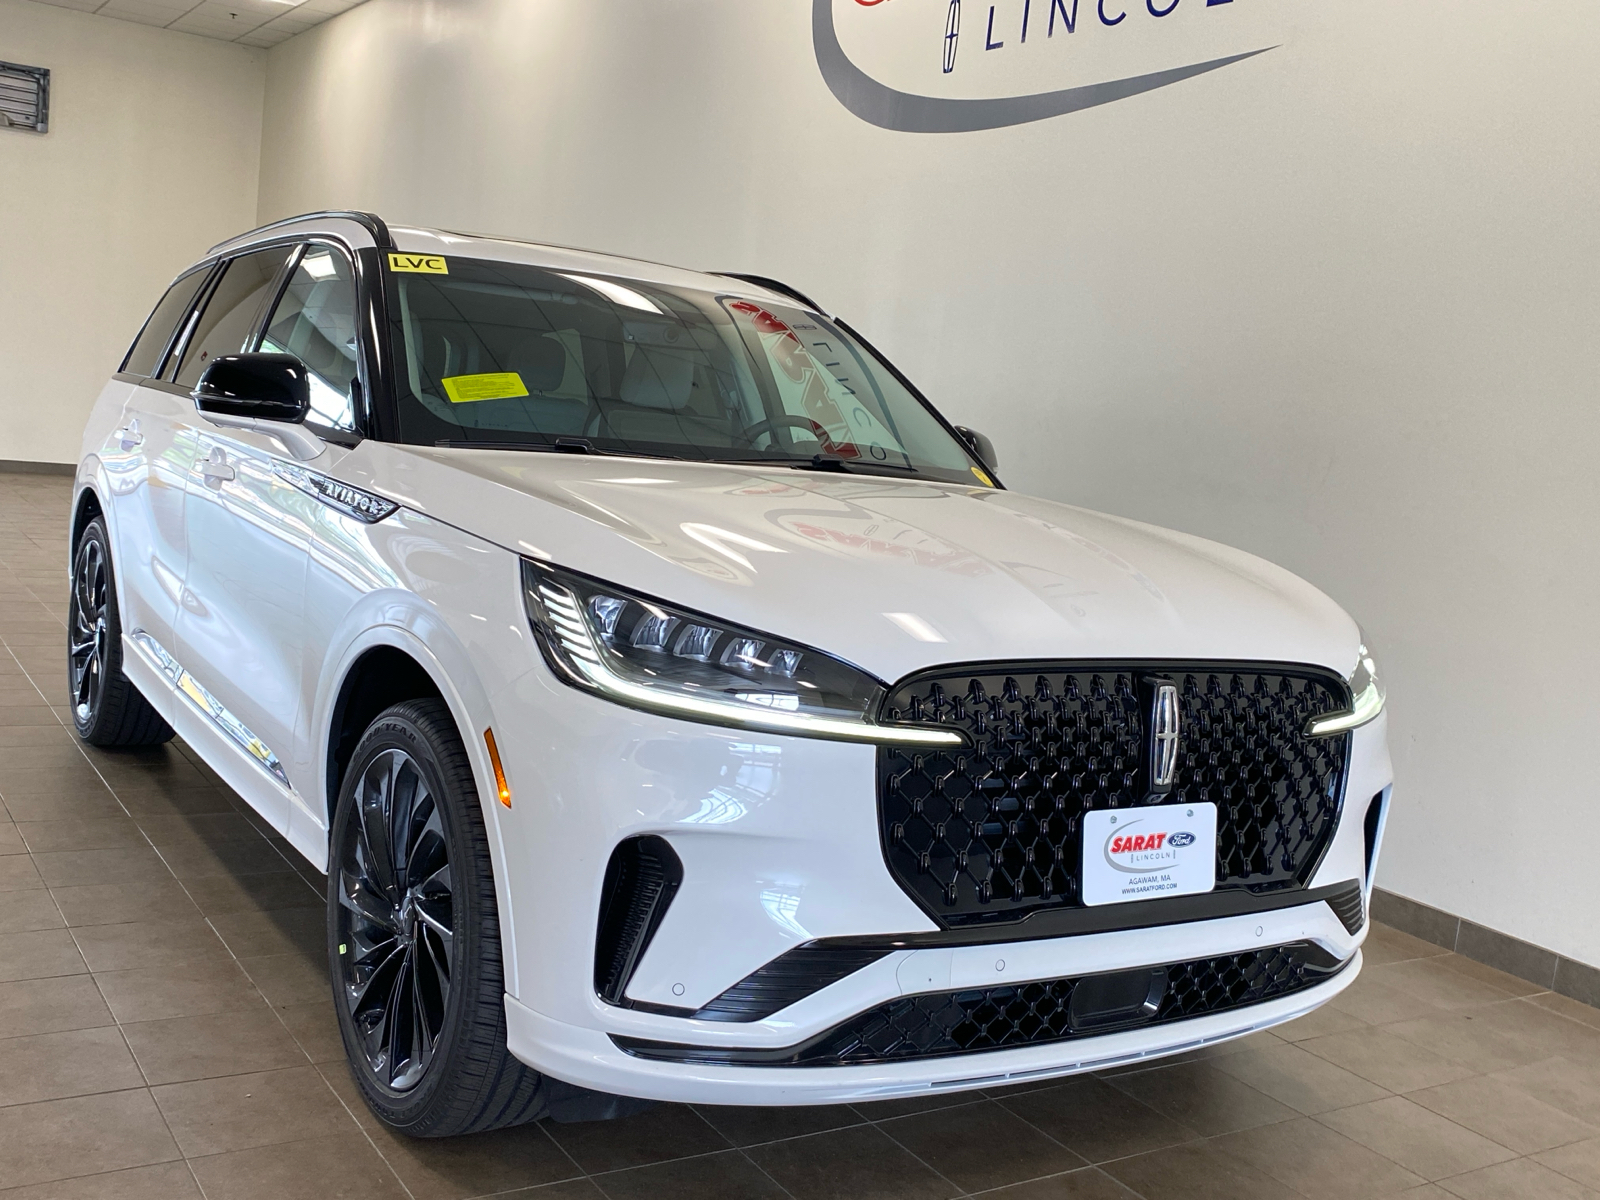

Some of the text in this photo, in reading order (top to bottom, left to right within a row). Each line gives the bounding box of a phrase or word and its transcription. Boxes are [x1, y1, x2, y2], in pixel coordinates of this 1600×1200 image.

[393, 257, 442, 269] LVC
[325, 481, 380, 515] AVIATOR
[1111, 833, 1191, 853] SARAT Ford
[1136, 853, 1170, 861] LINCOLN
[1128, 874, 1171, 885] AGAWAM, MA
[1122, 884, 1177, 894] WWW.SARATFORD.COM
